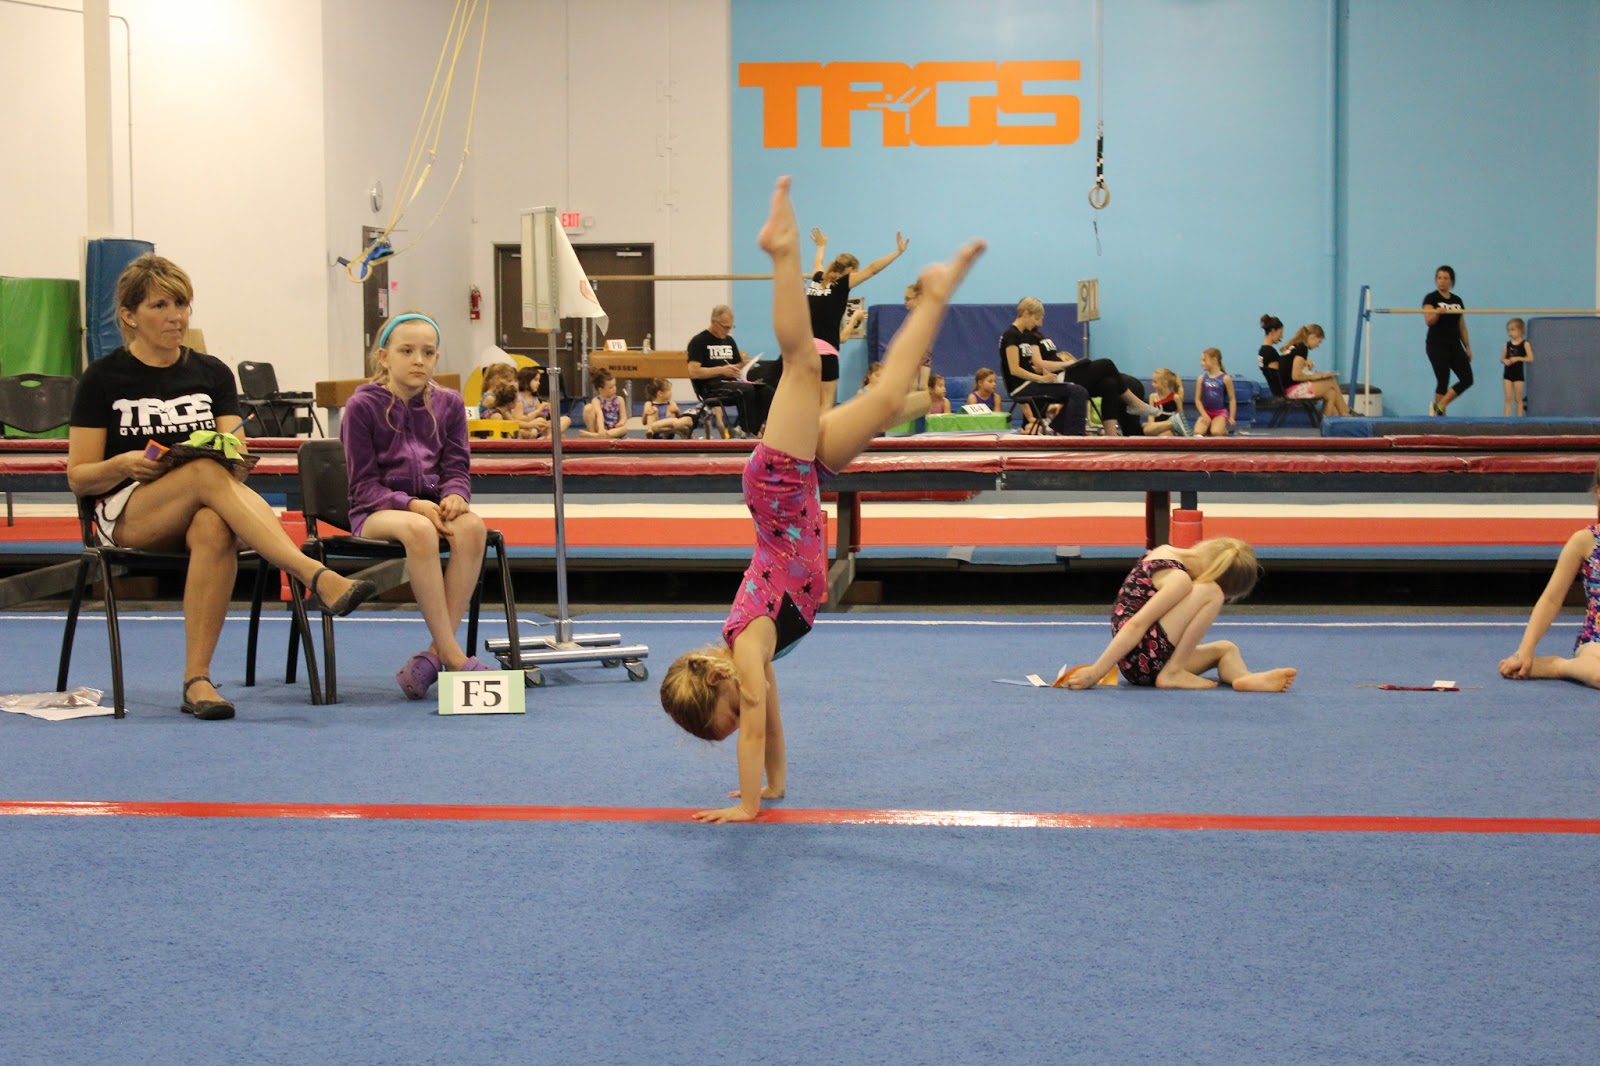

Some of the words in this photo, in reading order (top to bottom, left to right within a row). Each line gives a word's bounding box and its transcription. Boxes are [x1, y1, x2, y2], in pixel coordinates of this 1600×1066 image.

[738, 60, 1081, 148] TRGS
[562, 213, 581, 227] EXIT
[112, 393, 214, 427] TRGS
[461, 680, 502, 707] F5
